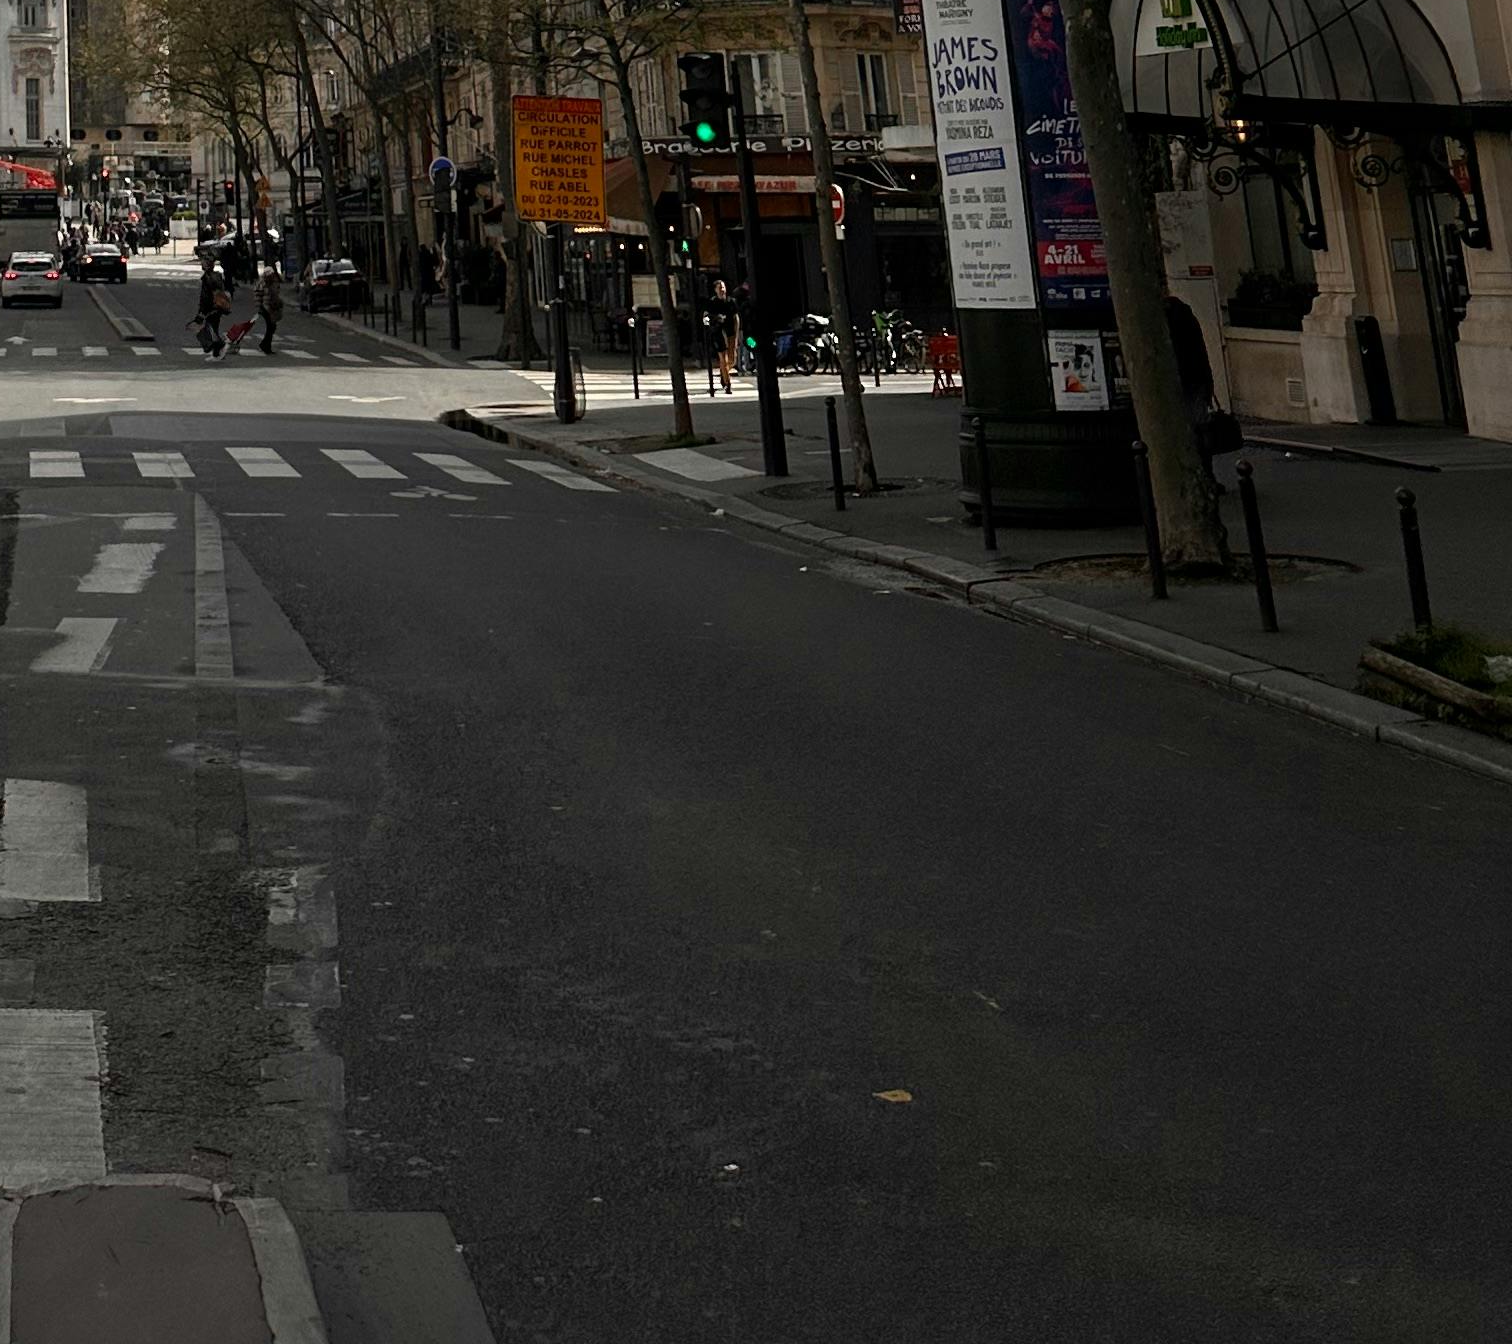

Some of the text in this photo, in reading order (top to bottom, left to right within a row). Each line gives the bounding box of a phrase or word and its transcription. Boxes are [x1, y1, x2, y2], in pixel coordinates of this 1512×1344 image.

[932, 36, 999, 69] JAMES
[936, 66, 998, 99] BROWN
[518, 112, 599, 125] CIRCULATION
[520, 139, 598, 152] RUE PARROT
[523, 152, 596, 166] RUE MICHEL
[531, 166, 588, 179] CHASLES
[530, 180, 590, 193] RUE ABEL
[522, 194, 599, 207] DU 02-10-2023
[522, 208, 600, 220] AU 31-05-2024
[1044, 254, 1085, 265] AVRIL
